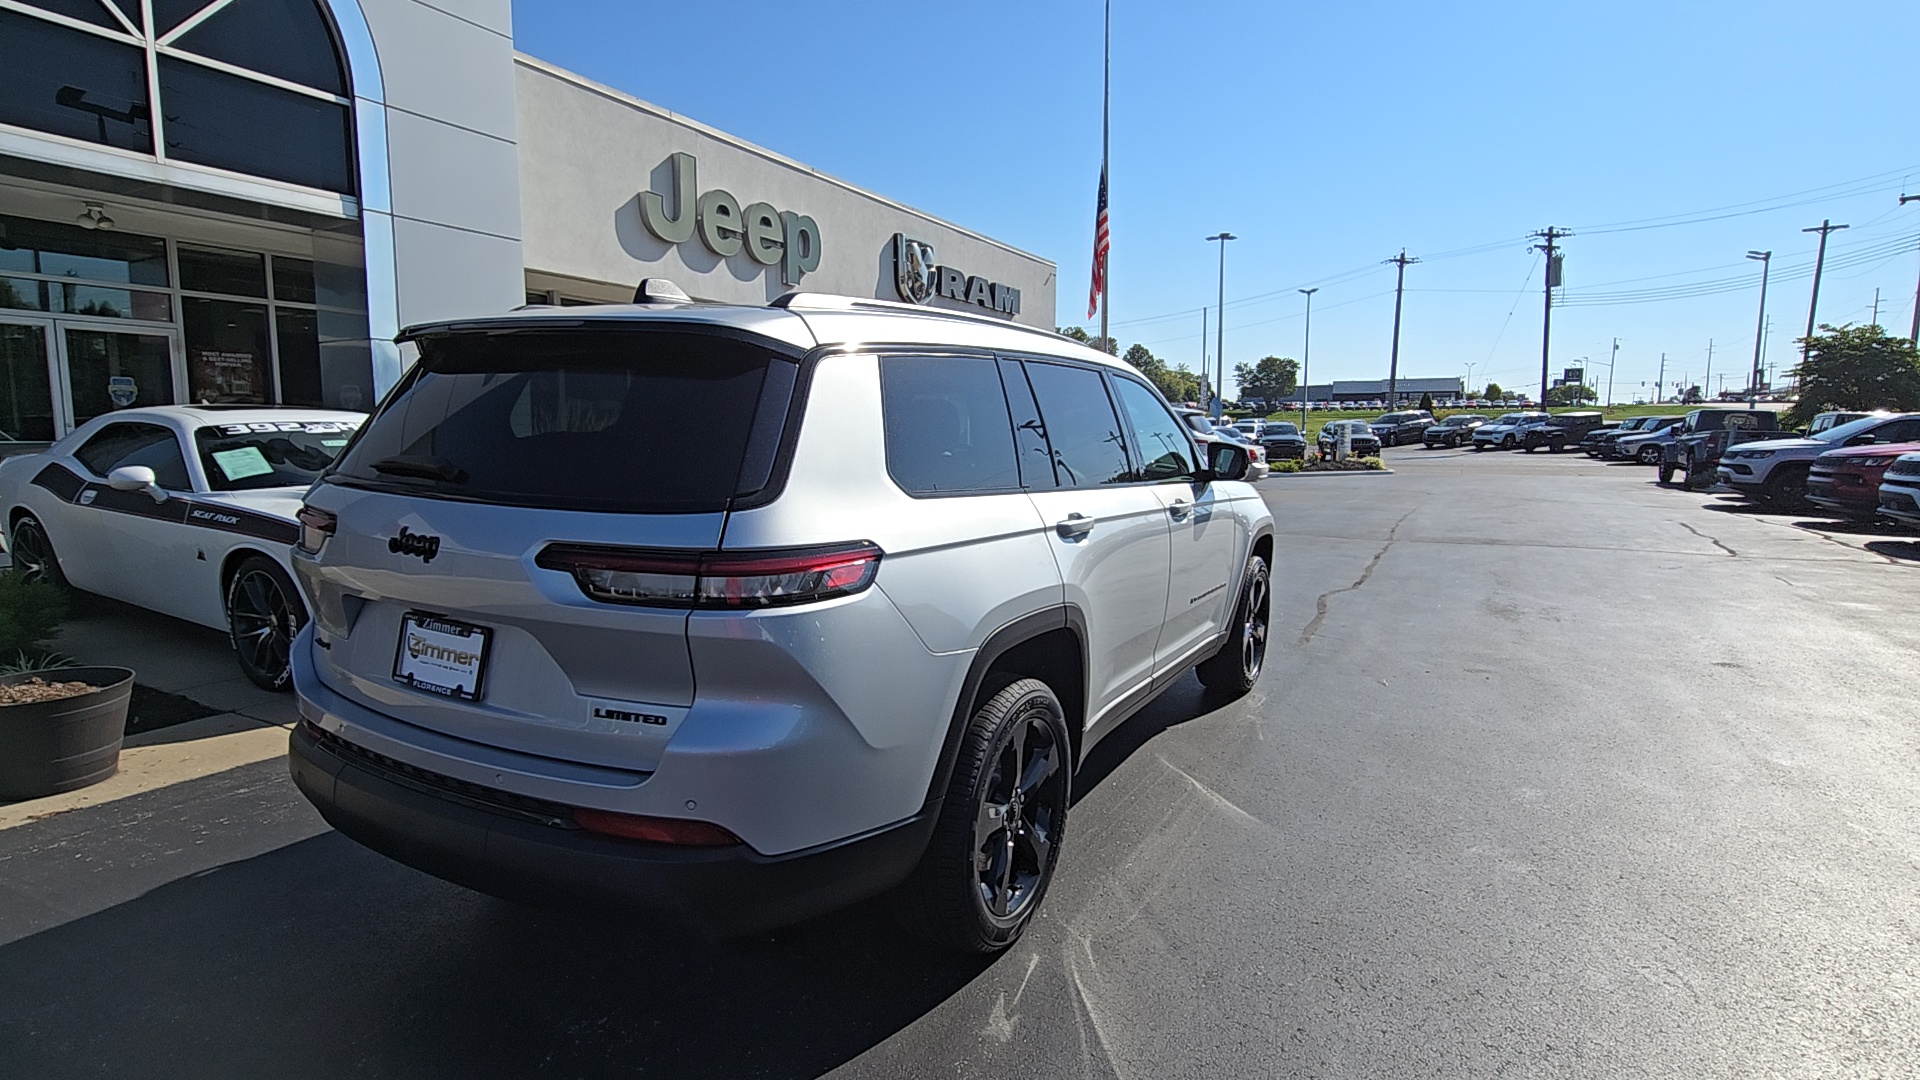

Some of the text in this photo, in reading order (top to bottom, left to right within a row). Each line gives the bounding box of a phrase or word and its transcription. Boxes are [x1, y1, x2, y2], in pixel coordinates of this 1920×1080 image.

[639, 151, 822, 286] Jeep
[936, 265, 1021, 315] RAM
[220, 422, 305, 434] 392
[190, 509, 241, 525] SCAT PACK
[388, 526, 440, 564] Jeep
[422, 617, 463, 635] Zimmer
[410, 635, 480, 667] Zimmer
[412, 680, 453, 696] FLORENCE
[593, 708, 668, 726] LIMITED
